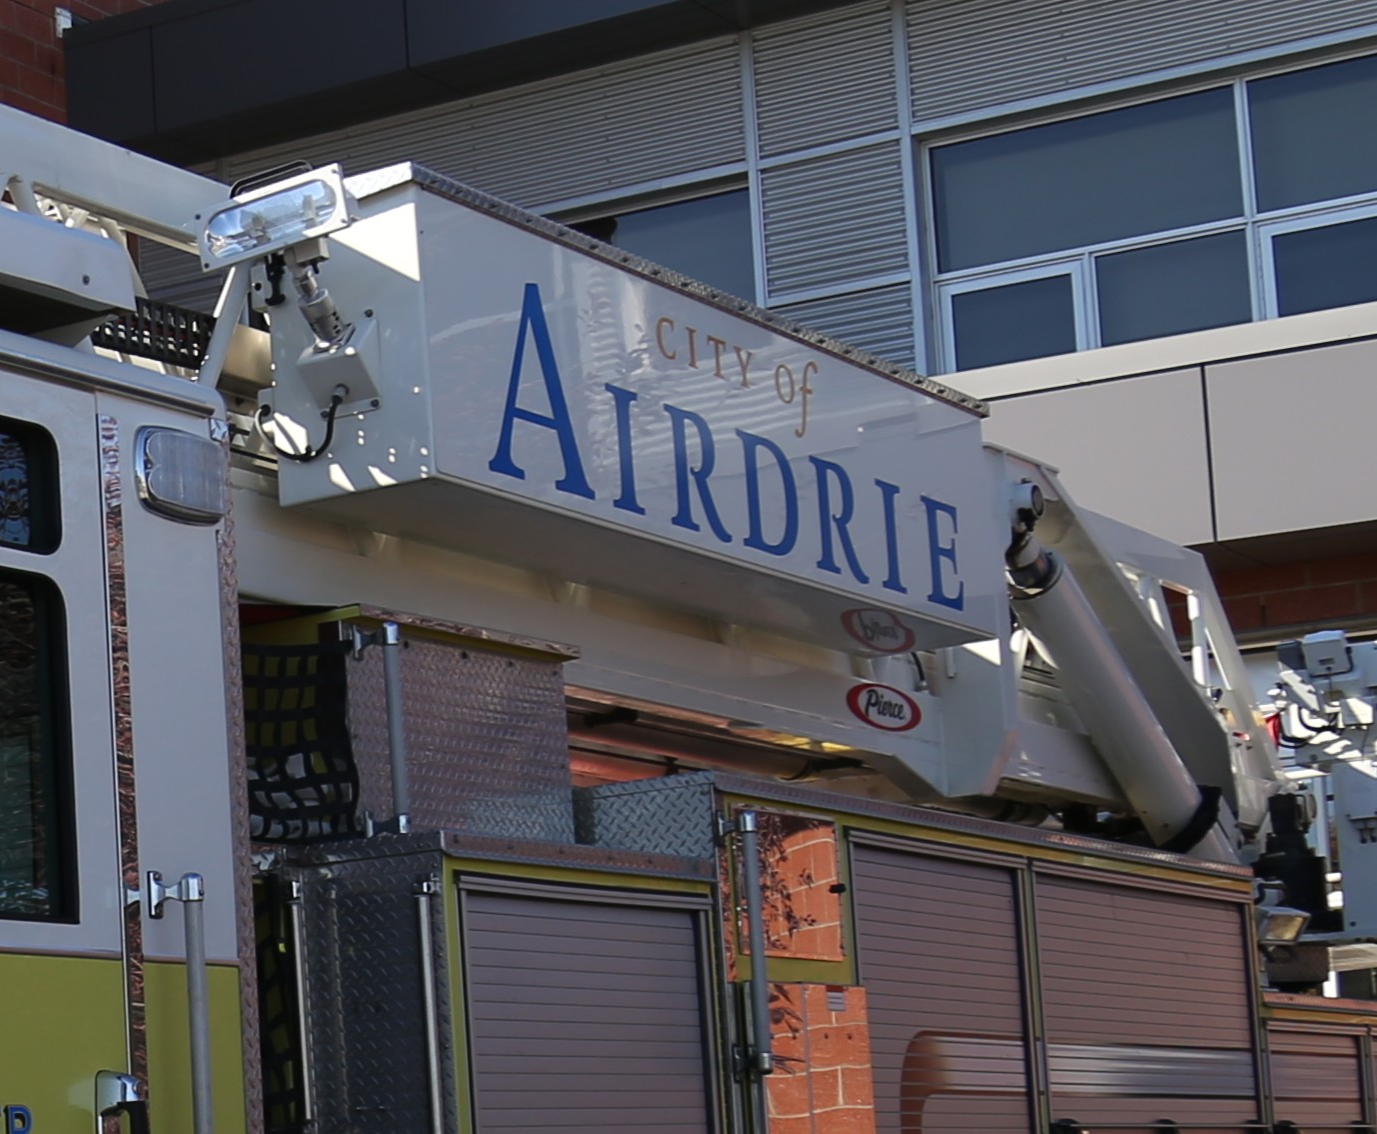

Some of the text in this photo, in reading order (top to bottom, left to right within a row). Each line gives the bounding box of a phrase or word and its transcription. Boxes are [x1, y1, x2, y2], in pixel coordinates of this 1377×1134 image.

[655, 316, 754, 390] CITY
[489, 283, 962, 610] AIRDRIE
[864, 688, 906, 721] Pierce
